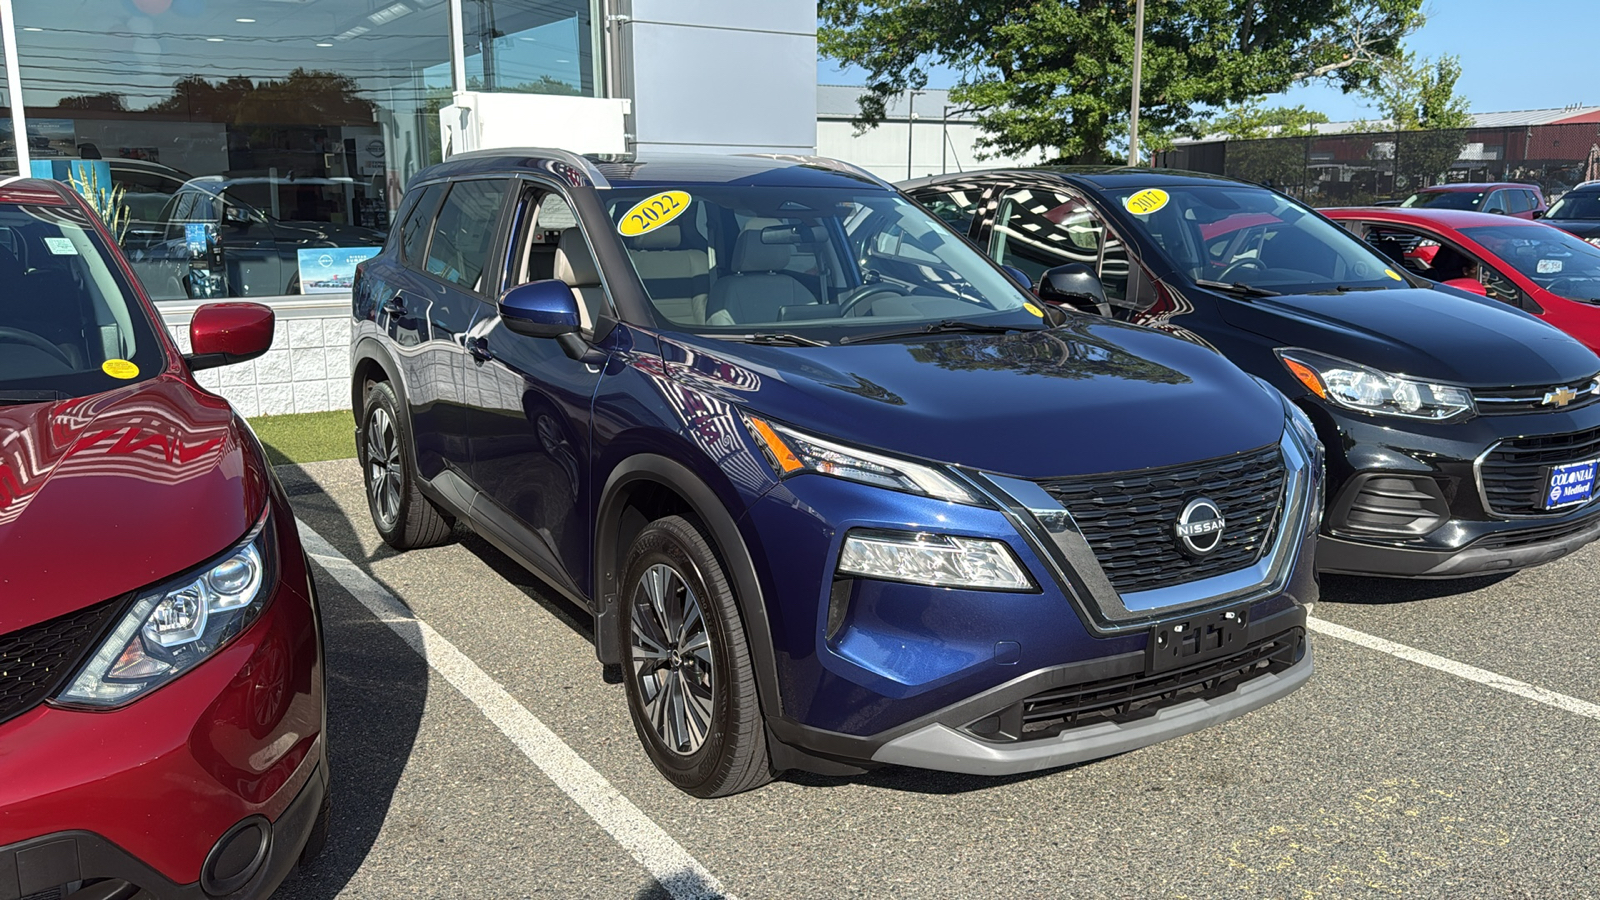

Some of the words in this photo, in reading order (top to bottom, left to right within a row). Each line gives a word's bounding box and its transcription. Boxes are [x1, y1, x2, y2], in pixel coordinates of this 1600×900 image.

[1132, 191, 1160, 212] 2017
[631, 195, 680, 229] 2022
[1551, 468, 1593, 487] COLONIAL
[1563, 482, 1590, 496] Medford
[1178, 519, 1225, 535] NISSAN
